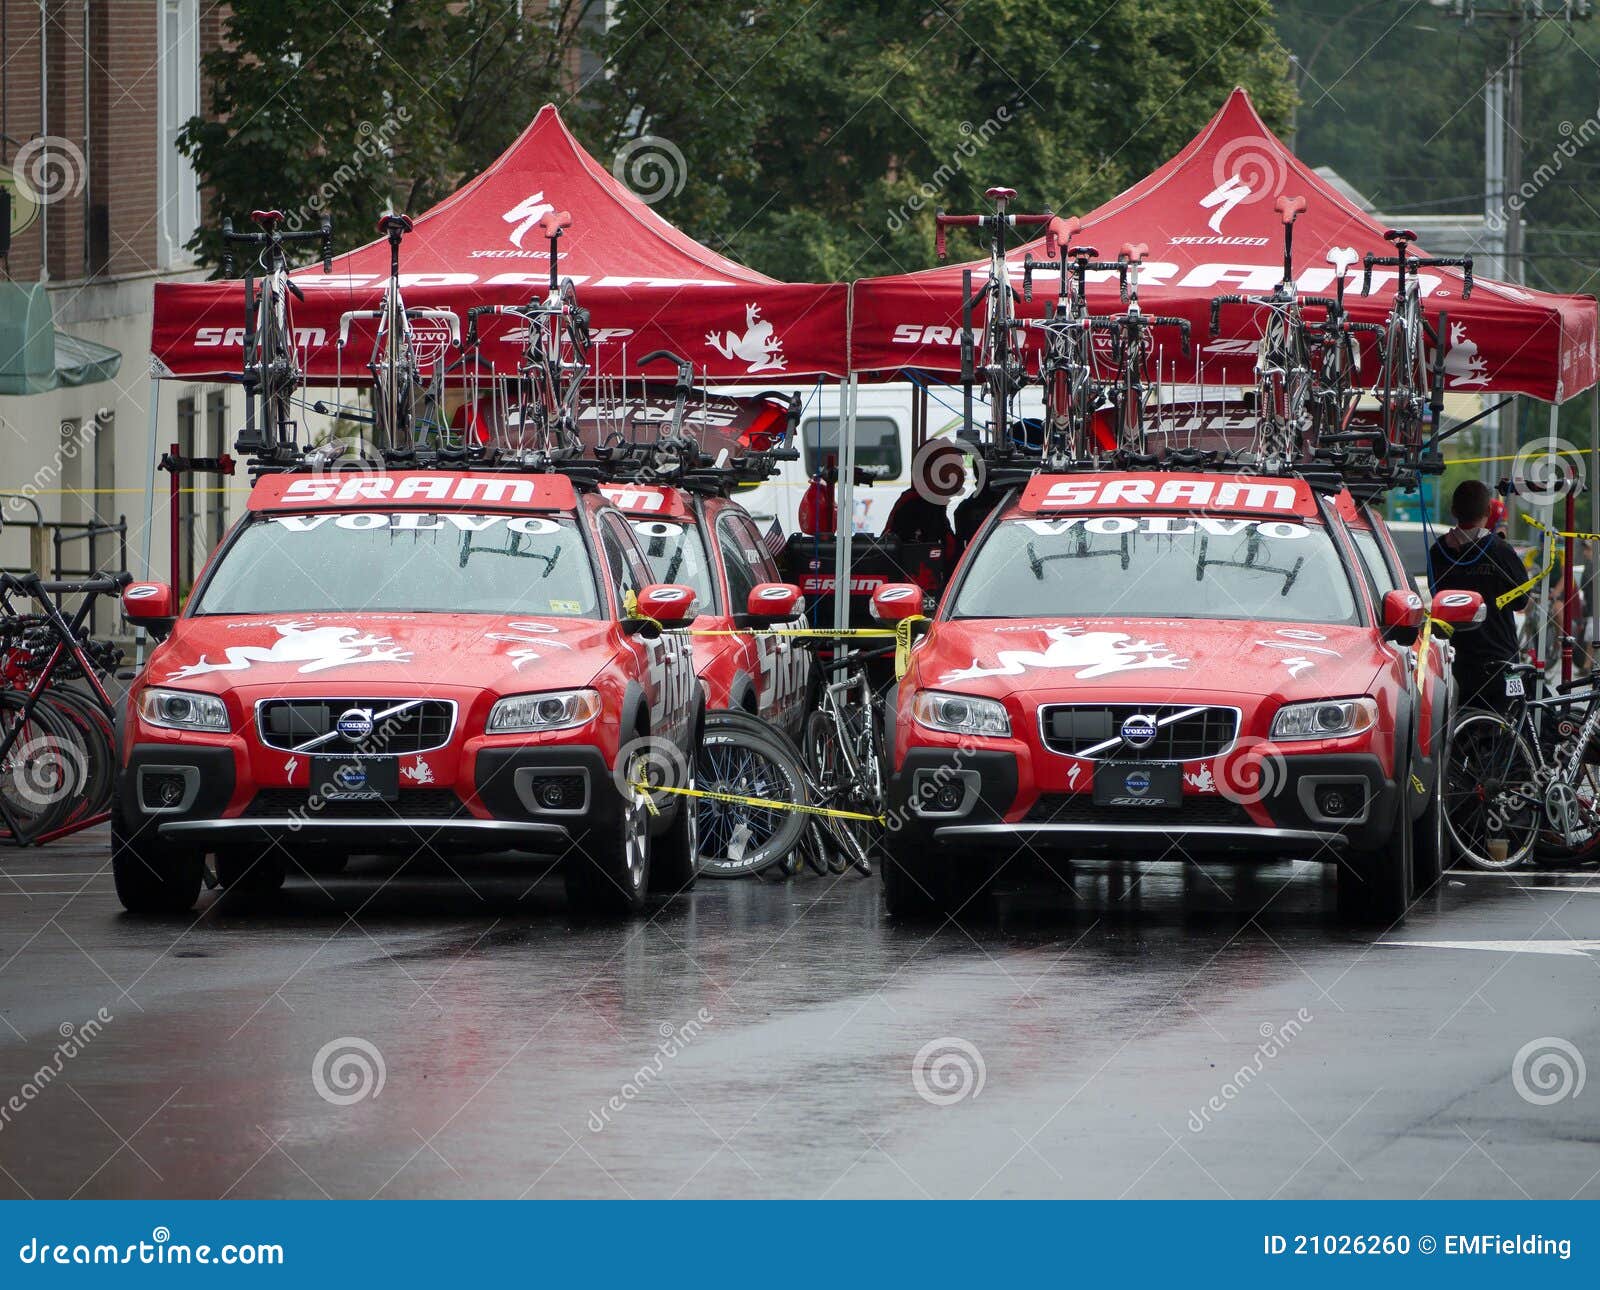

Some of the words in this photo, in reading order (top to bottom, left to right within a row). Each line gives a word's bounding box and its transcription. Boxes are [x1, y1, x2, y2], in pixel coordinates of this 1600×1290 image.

[1167, 236, 1270, 246] SPECIALIZED
[194, 327, 326, 347] SRM
[499, 327, 634, 342] ZPP
[892, 324, 1027, 348] SRA
[655, 397, 738, 411] NEUTAL
[280, 476, 536, 503] SRAM
[1041, 479, 1297, 510] SRAM
[274, 513, 561, 535] VOLVO
[1014, 517, 1312, 539] VOLVO
[804, 578, 884, 591] SRM
[1509, 680, 1521, 694] 586
